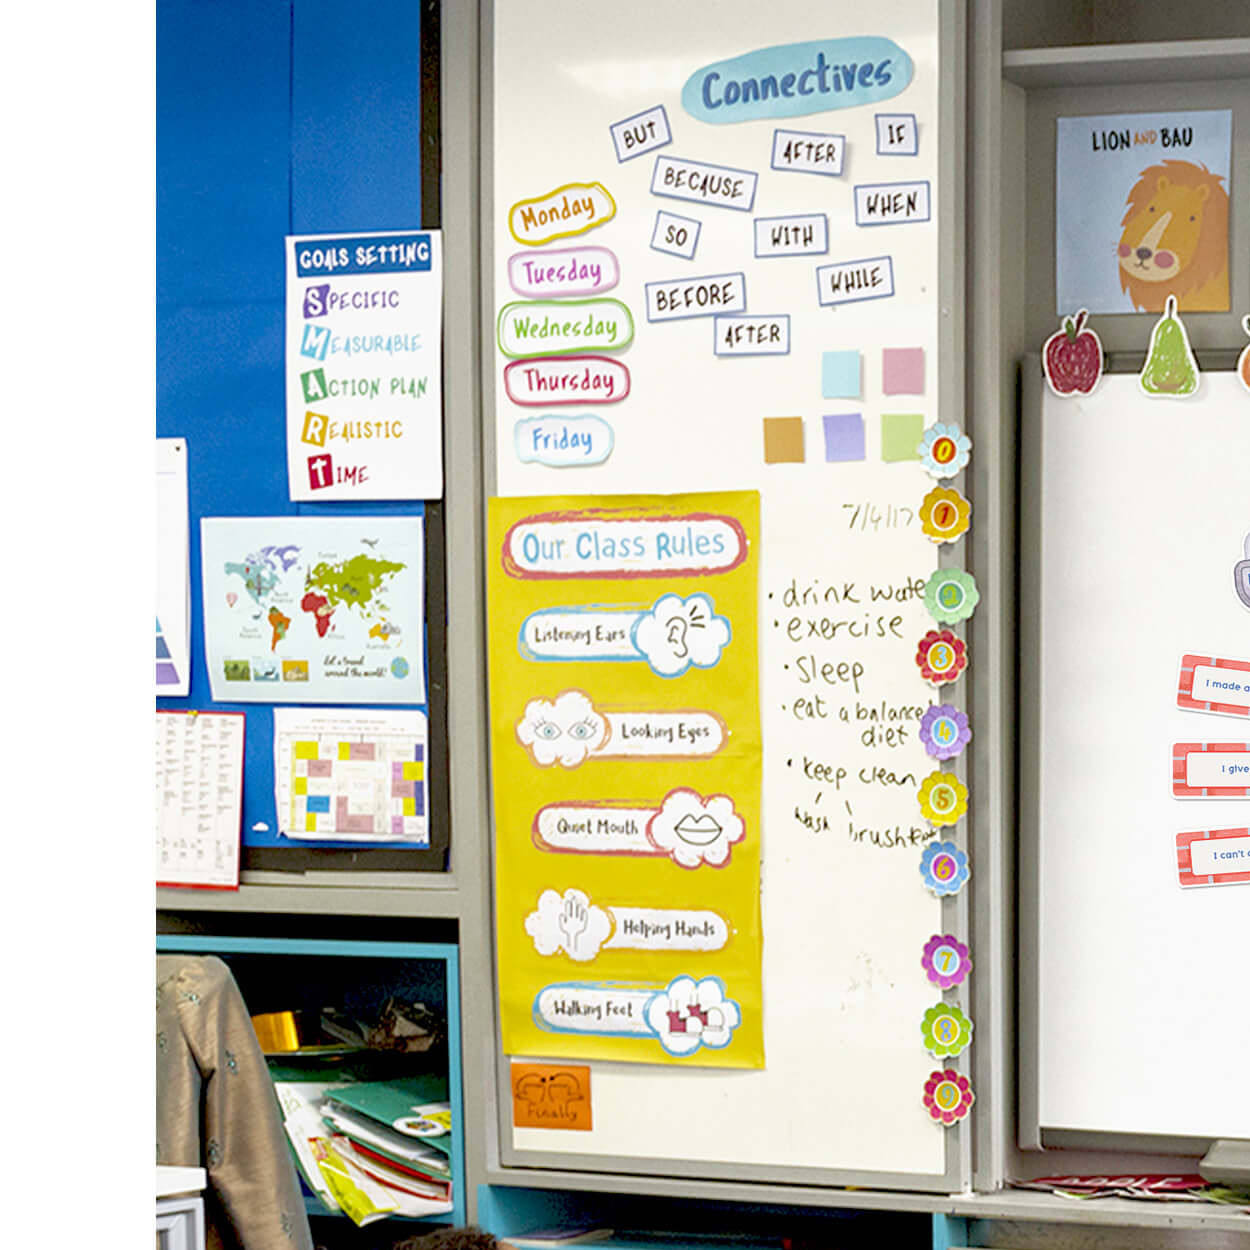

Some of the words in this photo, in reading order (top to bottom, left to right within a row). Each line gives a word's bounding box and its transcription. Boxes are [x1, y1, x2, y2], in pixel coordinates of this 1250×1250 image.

[702, 53, 892, 109] Connectives
[624, 122, 656, 149] BUT
[888, 124, 905, 145] IF
[1092, 130, 1130, 150] LION
[1134, 130, 1157, 145] AND
[1161, 127, 1193, 147] BAU
[783, 142, 836, 163] AFTER
[664, 167, 745, 198] BECAUSE
[520, 196, 595, 231] Monday
[867, 192, 918, 216] WHEN
[665, 227, 688, 246] SO
[772, 225, 813, 246] WITH
[300, 247, 349, 271] GOALS
[356, 242, 430, 267] SETTING
[523, 259, 602, 286] Tuesday
[830, 265, 884, 292] WHILE
[303, 284, 400, 318] SPECIFIC
[656, 281, 735, 311] BEFORE
[514, 316, 618, 343] Wednesday
[725, 325, 781, 347] AFTER
[301, 324, 421, 361] MEASURABLE
[301, 368, 379, 404] ACTION
[391, 376, 428, 398] PLAN
[524, 368, 614, 396] Thursday
[302, 411, 402, 447] REALISTIC
[532, 427, 593, 454] Friday
[308, 454, 369, 490] TIME
[940, 506, 949, 524] 1
[523, 532, 565, 563] Our
[576, 530, 645, 561] Class
[656, 527, 725, 560] Rules
[783, 579, 860, 608] drink
[871, 577, 926, 602] wate
[943, 586, 957, 606] 2
[534, 625, 591, 645] Listening
[595, 625, 625, 642] Ears
[787, 613, 904, 642] exercise
[934, 646, 948, 667] 3
[1213, 681, 1241, 691] made
[793, 695, 828, 720] eat
[839, 707, 850, 722] a
[856, 700, 932, 722] balance
[622, 723, 673, 743] Looking
[678, 723, 710, 743] Eyes
[861, 725, 908, 747] diet
[938, 721, 951, 741] 4
[804, 757, 847, 790] keep
[859, 767, 916, 786] clean
[1229, 764, 1249, 775] give
[937, 789, 949, 809] 5
[557, 818, 592, 835] Quiet
[597, 818, 638, 835] Mouth
[1220, 850, 1244, 860] can't
[937, 858, 950, 878] 6
[623, 919, 671, 939] Helping
[675, 920, 715, 937] Hands
[940, 952, 953, 971] 7
[554, 1000, 601, 1021] Walking
[606, 1001, 632, 1016] Feet
[940, 1019, 952, 1042] 8
[942, 1085, 954, 1106] 9
[527, 1103, 578, 1121] Finally
